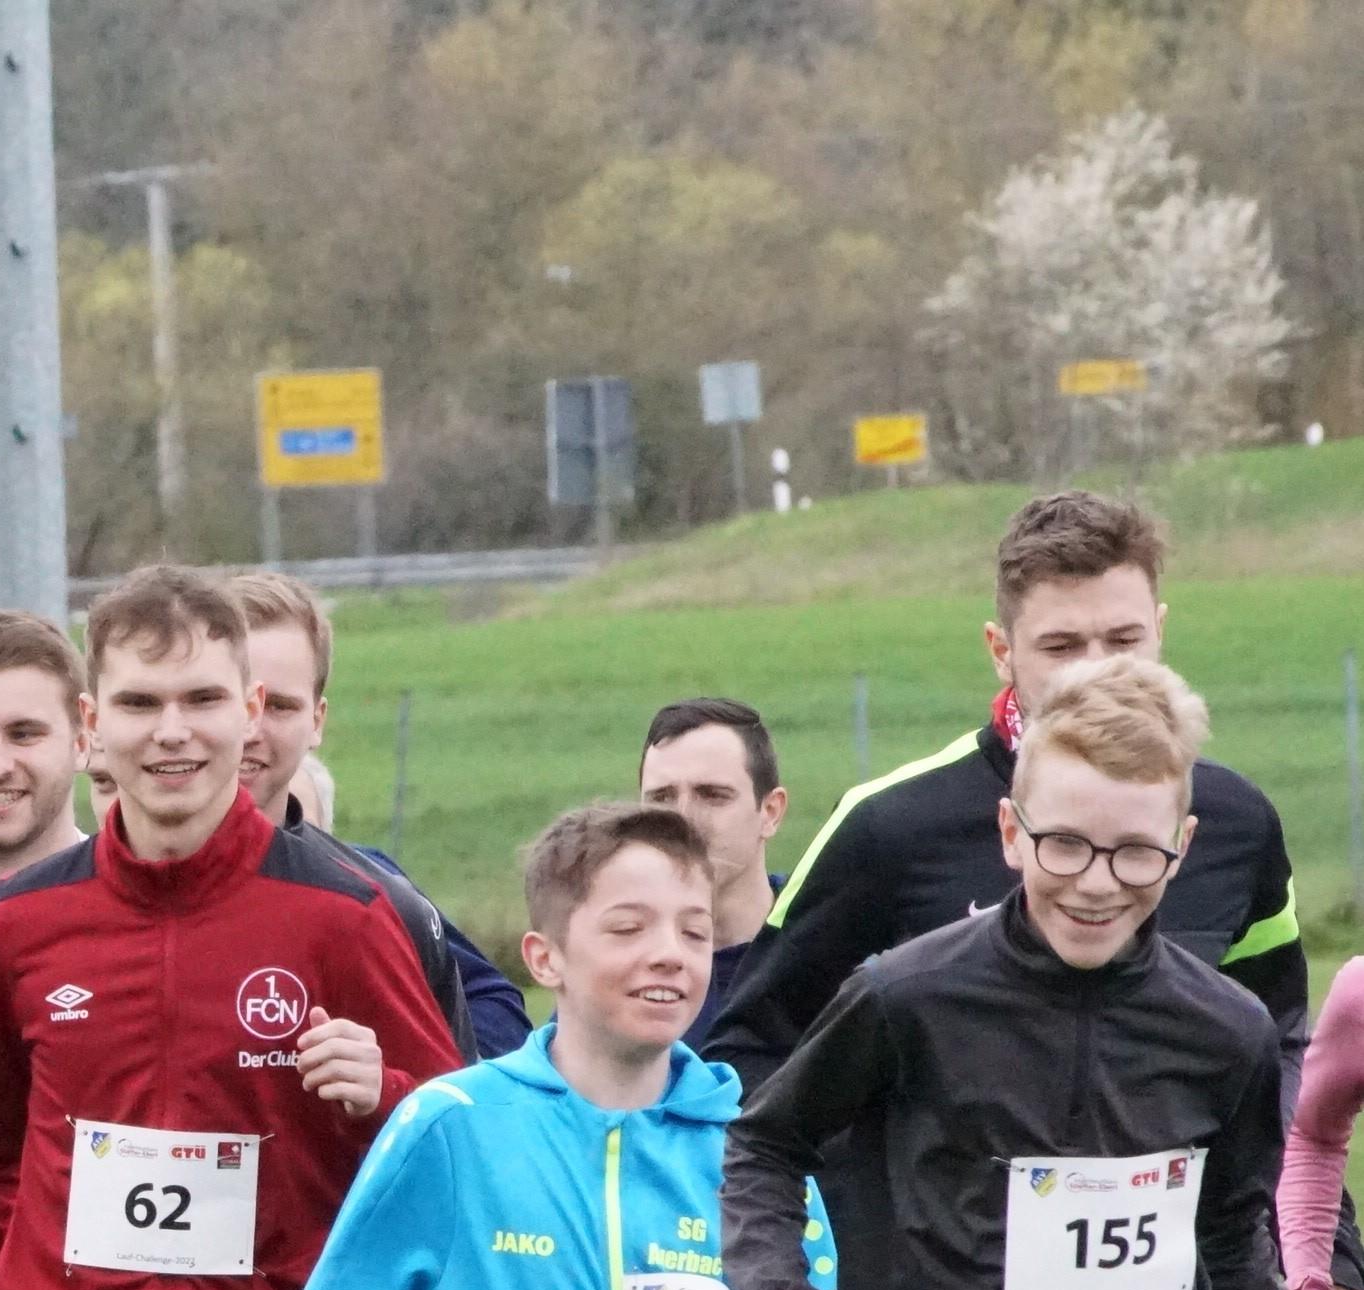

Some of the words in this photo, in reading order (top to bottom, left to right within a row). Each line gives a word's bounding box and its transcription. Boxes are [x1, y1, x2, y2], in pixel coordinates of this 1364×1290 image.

[265, 975, 280, 998] 1.
[50, 1008, 89, 1022] umbro
[246, 998, 299, 1025] FCN
[238, 1051, 267, 1069] Der
[171, 1145, 207, 1160] GTÜ
[1131, 1168, 1160, 1187] GTÜ
[125, 1182, 191, 1231] 62
[677, 1216, 708, 1242] SG
[1066, 1212, 1157, 1269] 155
[492, 1231, 555, 1257] JAKO
